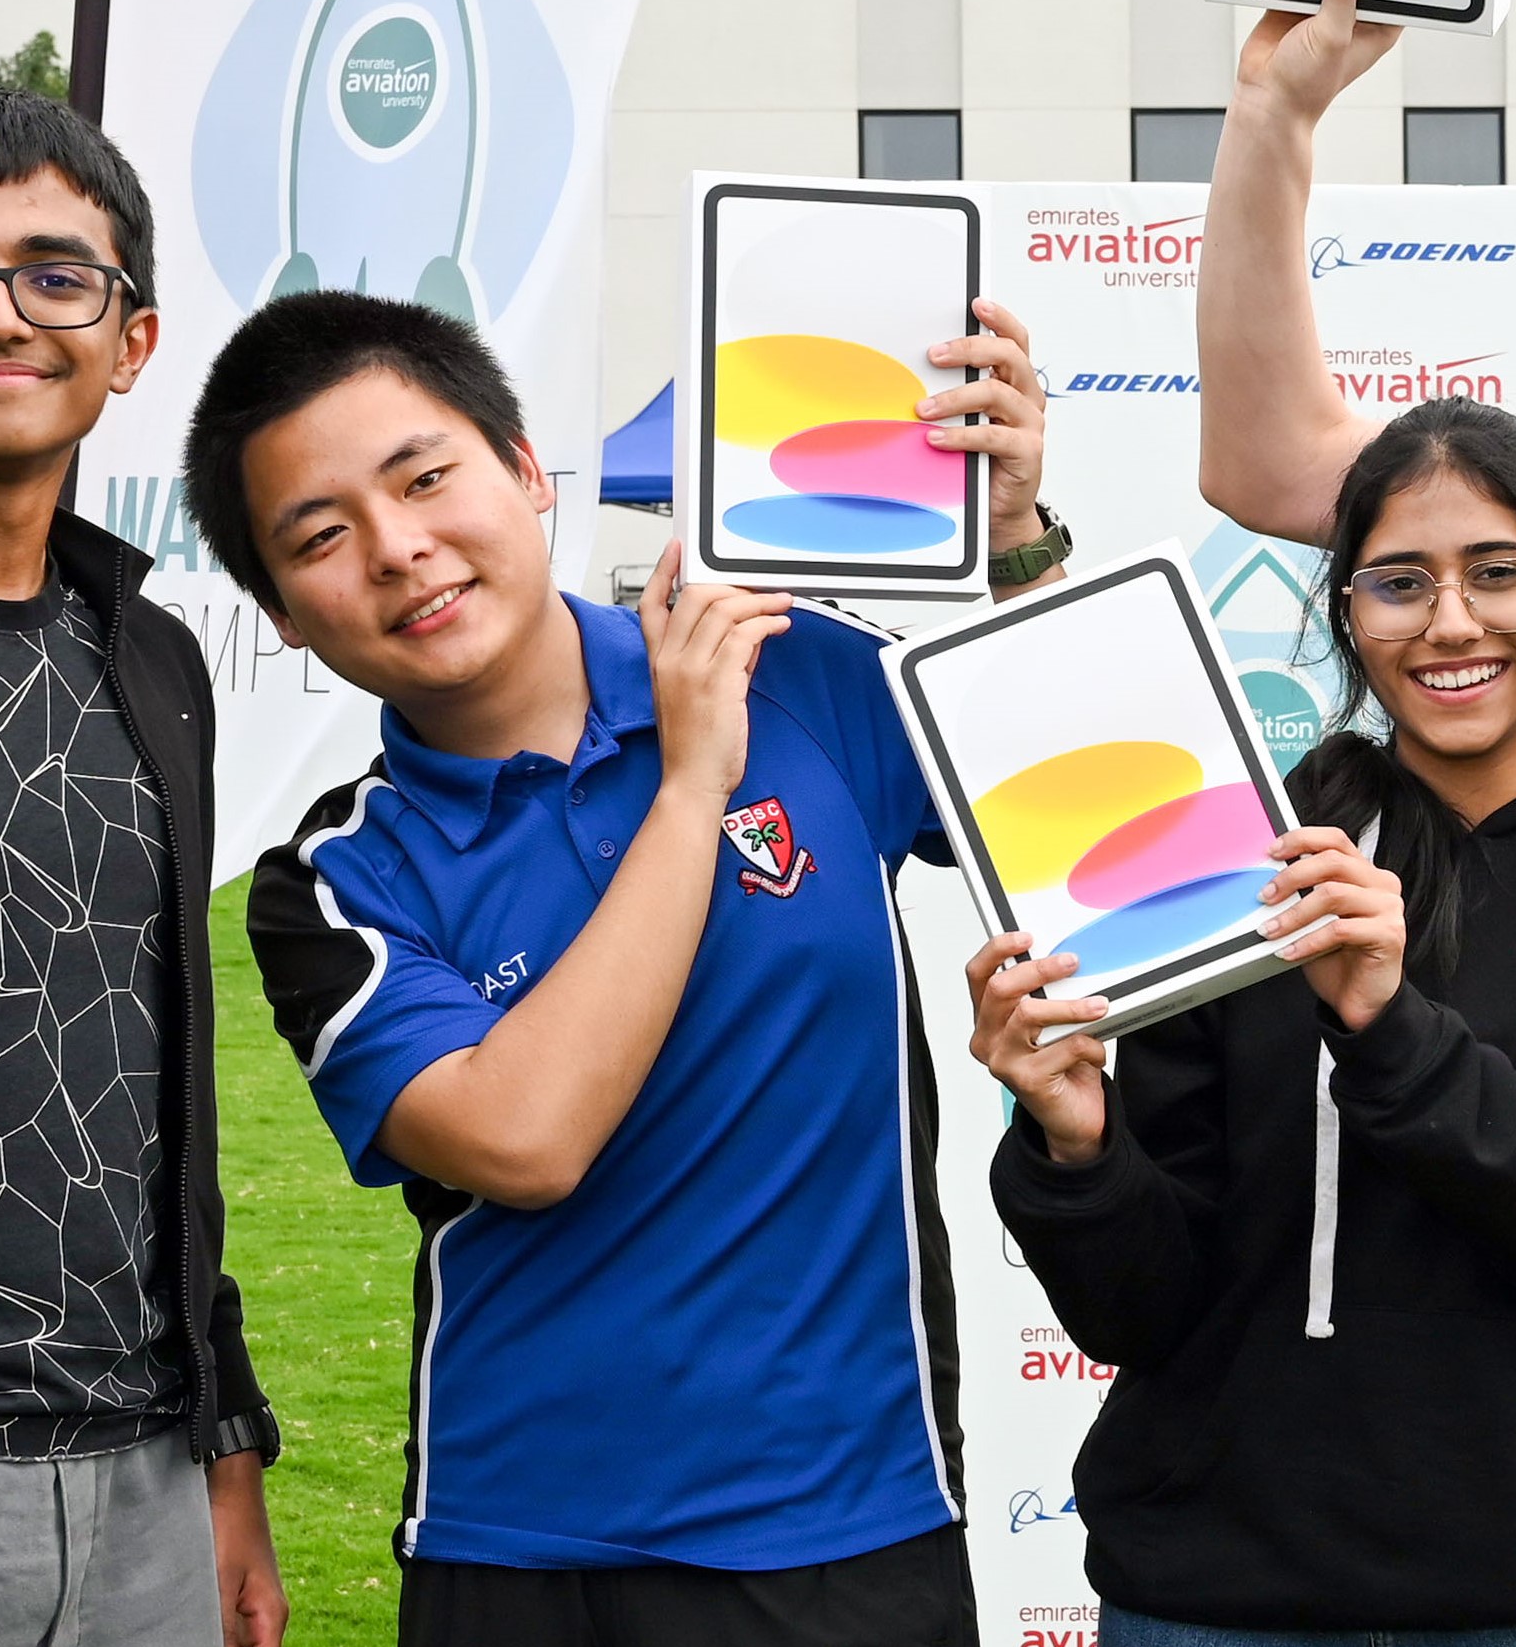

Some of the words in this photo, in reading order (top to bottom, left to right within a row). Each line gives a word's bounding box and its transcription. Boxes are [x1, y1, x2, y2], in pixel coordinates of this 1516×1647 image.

[347, 58, 395, 70] emirates
[345, 67, 430, 93] aviation
[382, 94, 428, 110] university
[1026, 207, 1120, 227] emirates
[1359, 241, 1516, 262] BOEING
[1103, 269, 1197, 288] universit
[1065, 373, 1202, 393] BOEIN
[724, 802, 781, 833] DESC
[1019, 1604, 1100, 1623] emirate
